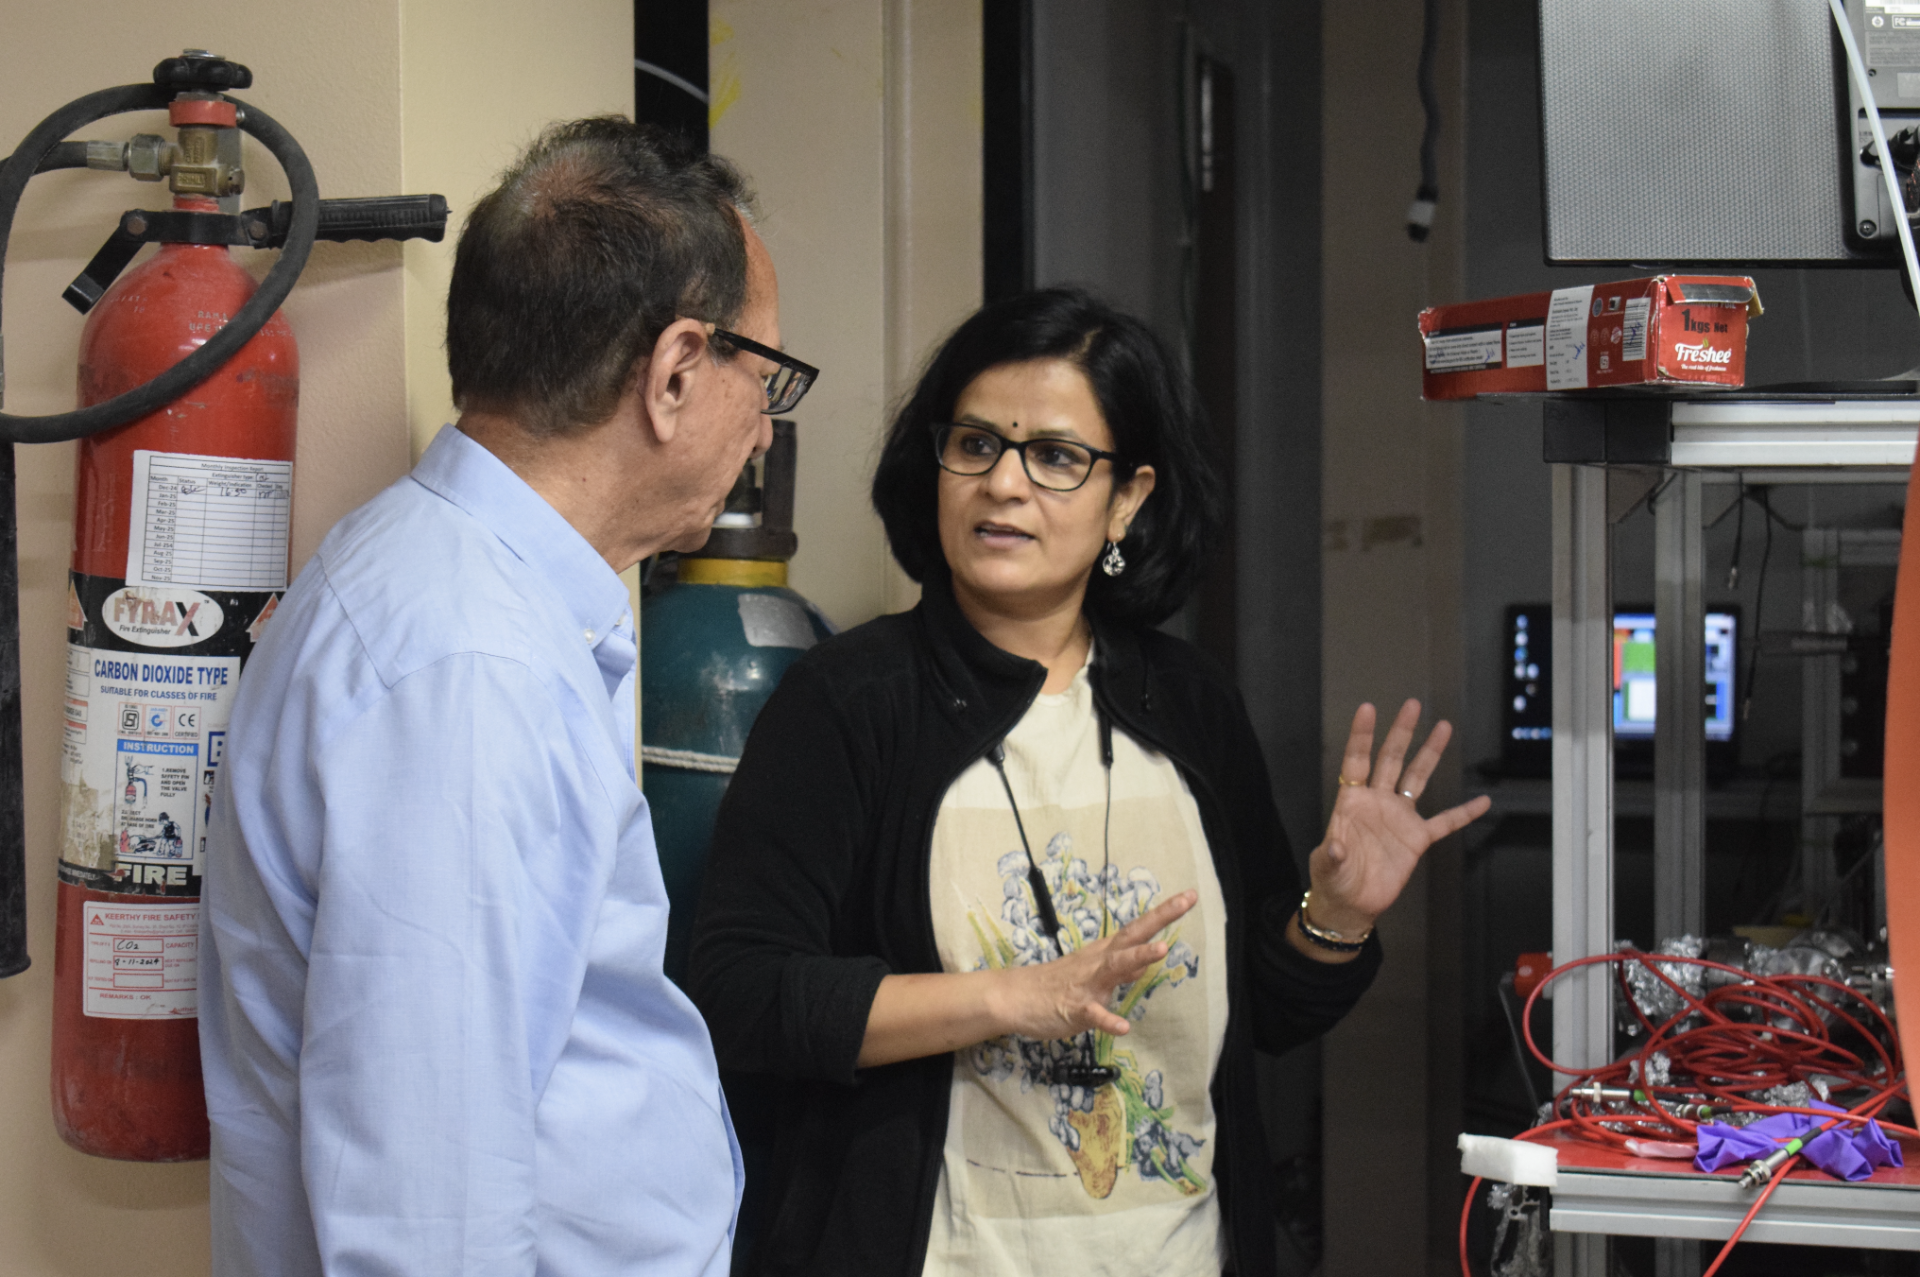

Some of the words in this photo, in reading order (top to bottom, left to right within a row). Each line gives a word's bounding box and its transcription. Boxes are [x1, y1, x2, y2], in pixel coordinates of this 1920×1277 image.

[1682, 308, 1710, 334] 1kgs
[1714, 322, 1728, 333] Net
[1674, 342, 1732, 364] Freshee
[114, 598, 200, 636] FYRAX
[119, 624, 130, 633] Fire
[131, 626, 171, 635] Extinguisher
[94, 659, 138, 682] CARBON
[142, 664, 193, 685] DIOXIDE
[197, 667, 228, 685] TYPE
[100, 685, 132, 697] SUITABLE
[134, 688, 148, 698] FOR
[150, 690, 186, 700] CLASSES
[188, 692, 198, 700] OF
[200, 692, 217, 701] FIRE
[123, 741, 194, 754] INSTRUCTION
[113, 862, 187, 886] FIRE
[163, 913, 196, 921] SAFETY
[99, 992, 134, 1000] REMARKS
